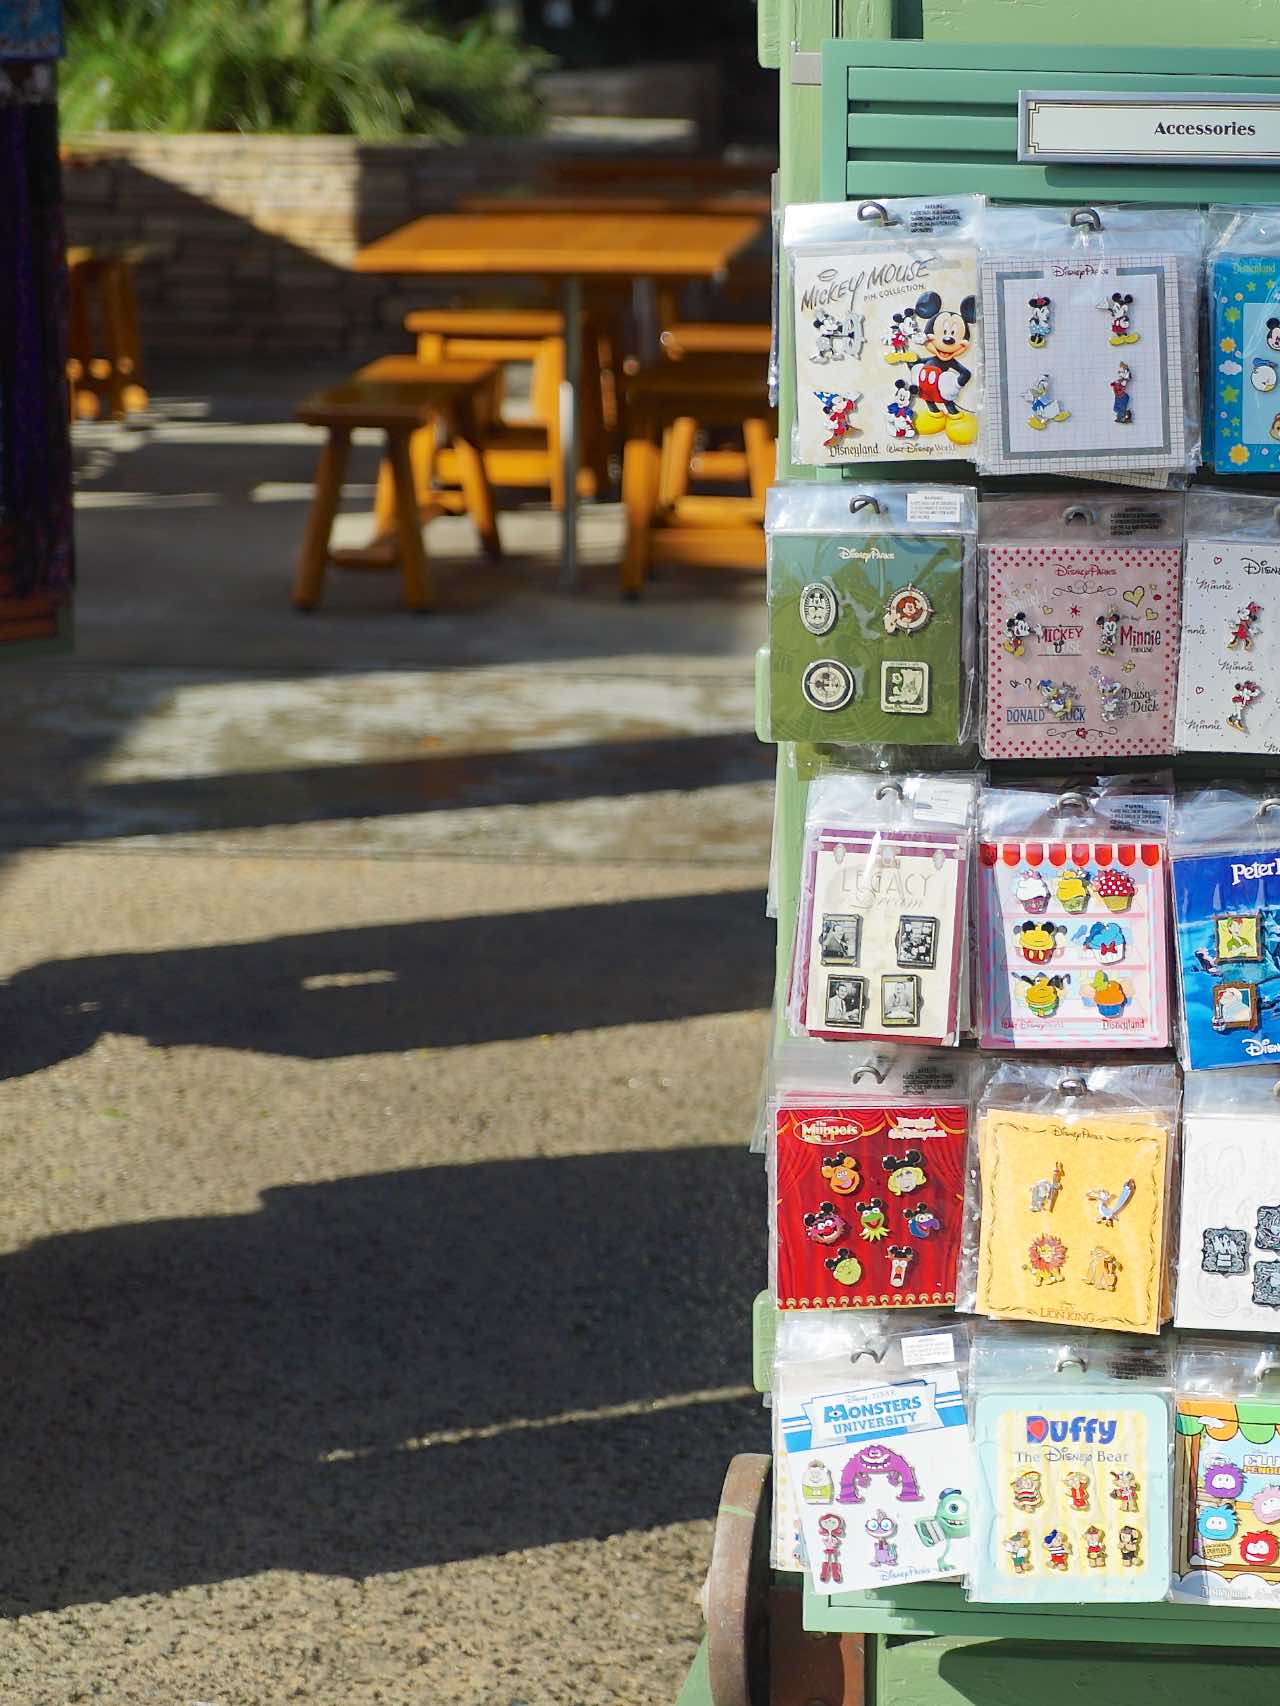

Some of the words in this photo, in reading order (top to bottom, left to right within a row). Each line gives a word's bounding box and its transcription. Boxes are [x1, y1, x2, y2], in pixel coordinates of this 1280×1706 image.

[1153, 121, 1257, 137] Accessories
[800, 271, 865, 313] MICKEY
[866, 257, 937, 290] MOUSE
[829, 443, 879, 458] Disneyland
[1196, 577, 1233, 591] Minnie
[1120, 625, 1161, 647] Minnie
[1218, 659, 1255, 672] Minnie
[1121, 688, 1153, 704] Daisy
[1007, 708, 1045, 723] DONALD
[1130, 702, 1160, 714] Duck
[1231, 861, 1276, 886] Peter
[802, 1124, 858, 1137] Muppets
[824, 1396, 922, 1423] MONSTERS
[833, 1412, 917, 1434] UNIVERSITY
[1026, 1415, 1117, 1445] Duffy
[1016, 1449, 1041, 1463] The
[1041, 1444, 1093, 1465] Disney
[1097, 1450, 1129, 1463] Bear
